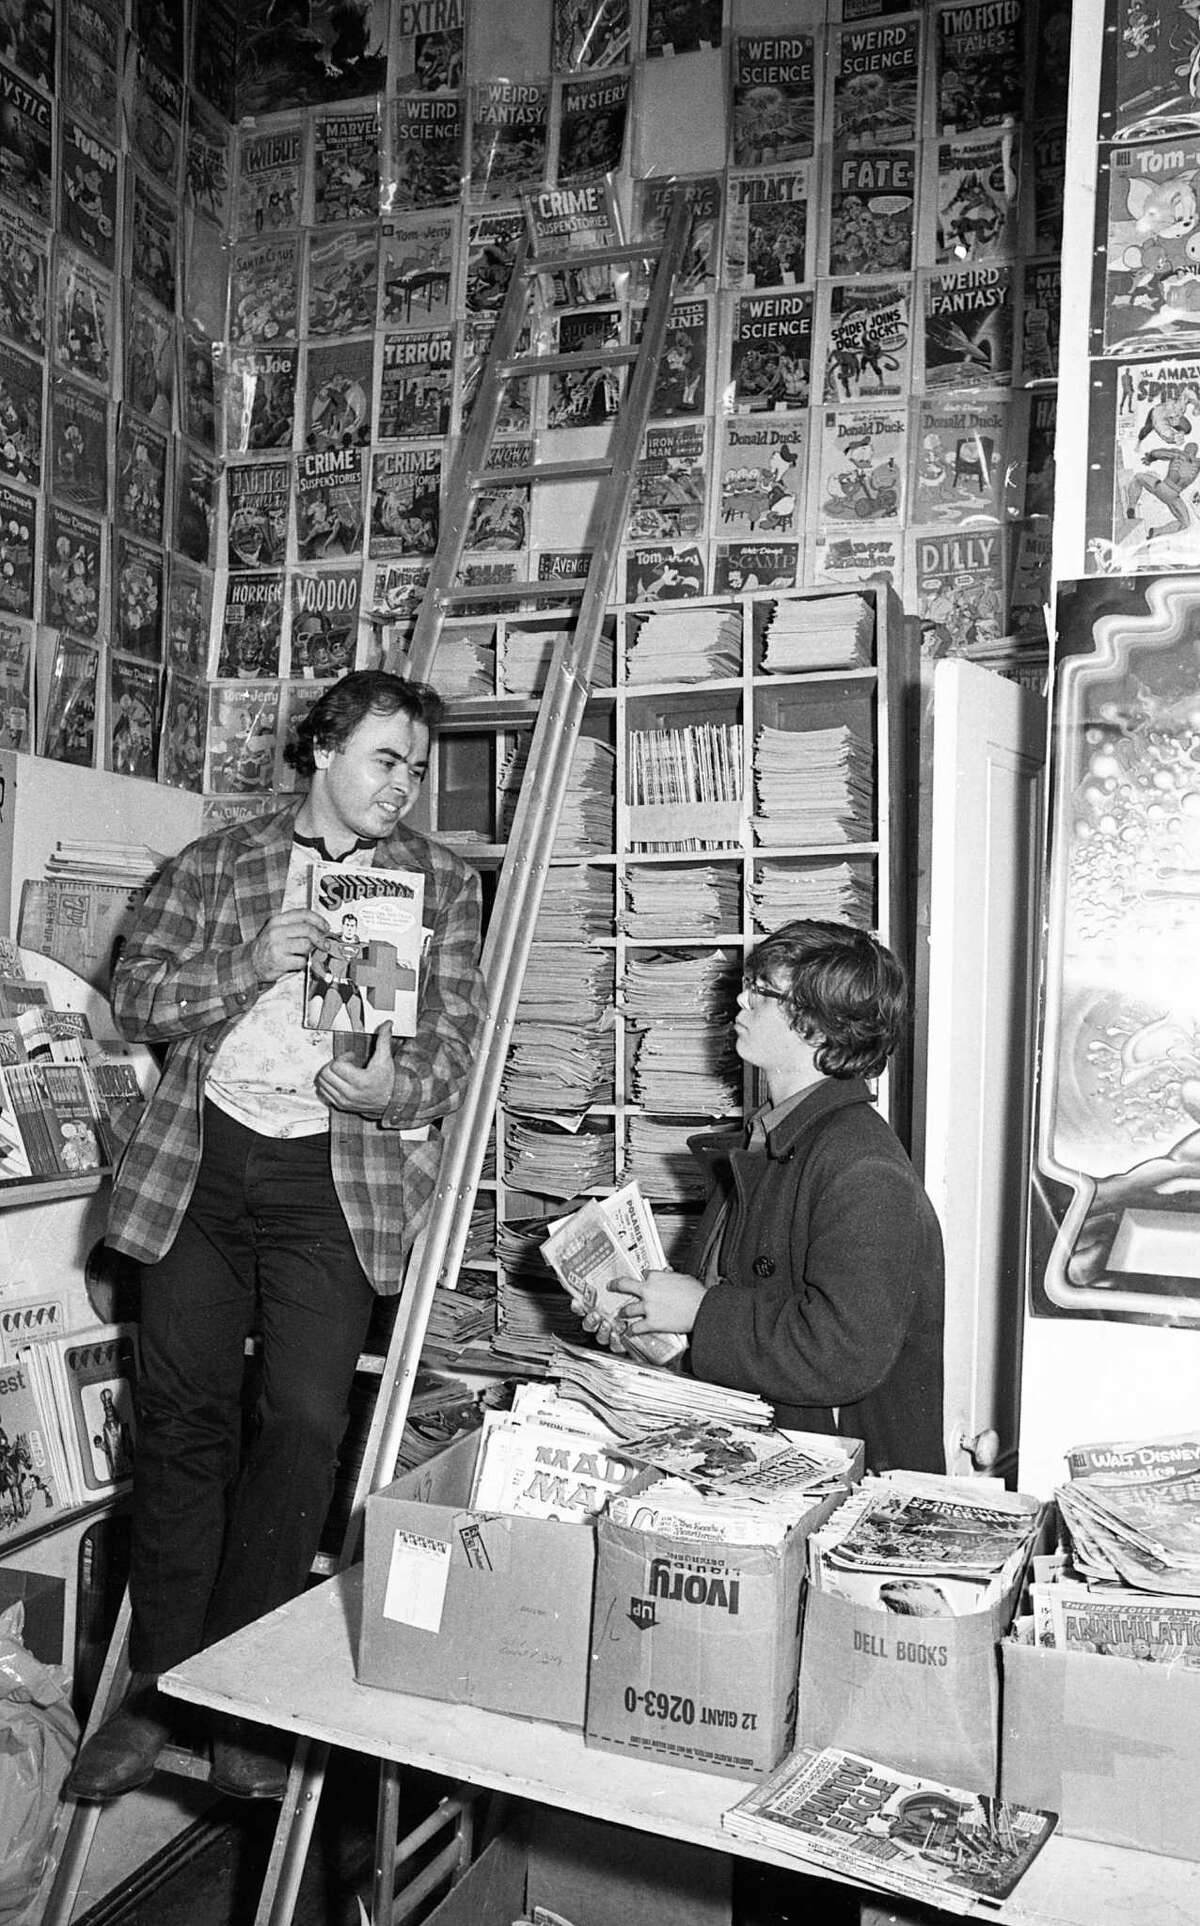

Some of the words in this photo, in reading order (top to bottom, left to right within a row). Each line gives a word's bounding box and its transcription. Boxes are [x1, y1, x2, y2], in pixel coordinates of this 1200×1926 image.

[749, 40, 803, 60] WEIRD
[851, 28, 906, 52] WEIRD
[956, 30, 1006, 54] TALES
[844, 49, 914, 73] SCIENCE
[742, 65, 811, 85] SCIENCE
[0, 74, 47, 124] YSTIC
[488, 86, 539, 103] WEIRD
[567, 83, 628, 112] MYSTERY
[406, 102, 457, 119] WEIRD
[478, 106, 546, 124] FANTASY
[326, 121, 378, 138] MARVEL
[400, 124, 461, 139] SCIENCE
[841, 160, 909, 189] FATE
[738, 176, 797, 204] PIRACY
[540, 187, 598, 218] CRIME
[940, 268, 999, 292] WEIRD
[750, 299, 803, 319] WEIRD
[931, 287, 1008, 315] FANTASY
[740, 319, 811, 339] SCIENCE
[831, 319, 867, 341] SPIDEY
[870, 309, 901, 328] JOINS
[385, 341, 452, 364] TERROR
[260, 355, 292, 374] Joe
[837, 421, 873, 437] Donald
[875, 420, 905, 435] Duck
[968, 413, 1003, 429] Duck
[649, 437, 674, 449] IRON
[729, 431, 768, 446] Donald
[770, 430, 801, 445] Duck
[305, 450, 354, 476] CRIME
[384, 450, 434, 473] CRIME
[552, 557, 590, 573] AVENGE
[636, 552, 662, 565] Tom
[728, 555, 796, 569] SCAMP
[921, 537, 995, 573] DILLY
[297, 578, 357, 612] VOODOO
[319, 874, 416, 911] SUPERMAN
[535, 1446, 634, 1485] MAD
[1090, 1453, 1136, 1468] WALT
[523, 1470, 597, 1515] MA
[633, 1604, 652, 1620] UP
[854, 1630, 888, 1658] DELL
[896, 1641, 948, 1667] BOOKS
[624, 1686, 695, 1725] 0263-0
[700, 1707, 738, 1728] GIANT
[742, 1713, 758, 1730] 12
[792, 1757, 874, 1827] PHANTOM
[827, 1773, 901, 1833] EAGLE
